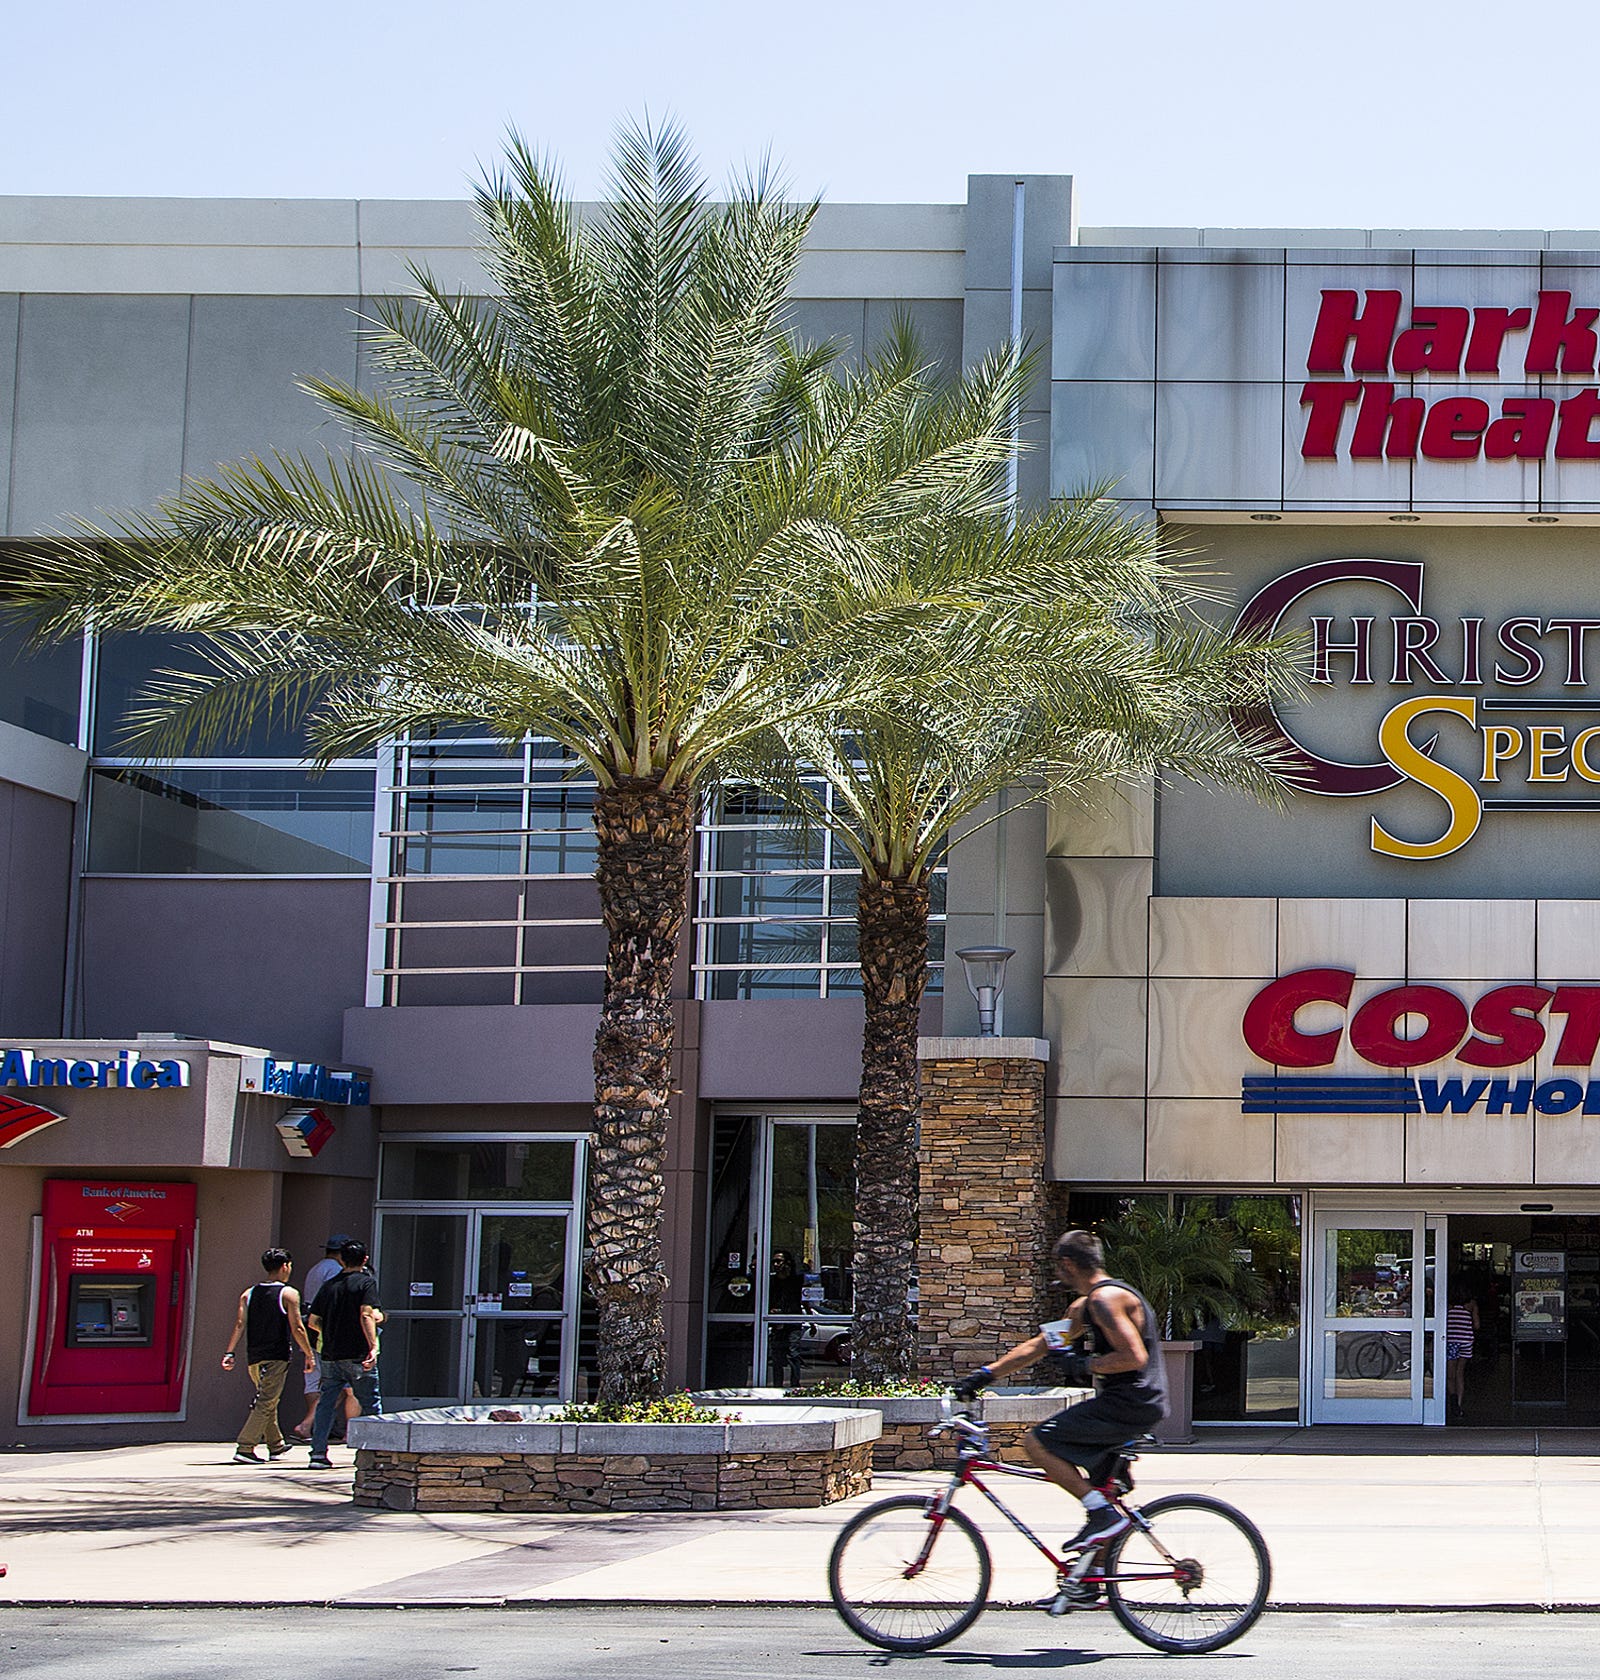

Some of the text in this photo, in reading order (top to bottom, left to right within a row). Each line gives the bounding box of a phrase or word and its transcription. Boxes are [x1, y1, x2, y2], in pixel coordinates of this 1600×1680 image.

[0, 1049, 190, 1089] America
[82, 1186, 167, 1200] Bank of America
[76, 1229, 94, 1237] ATM
